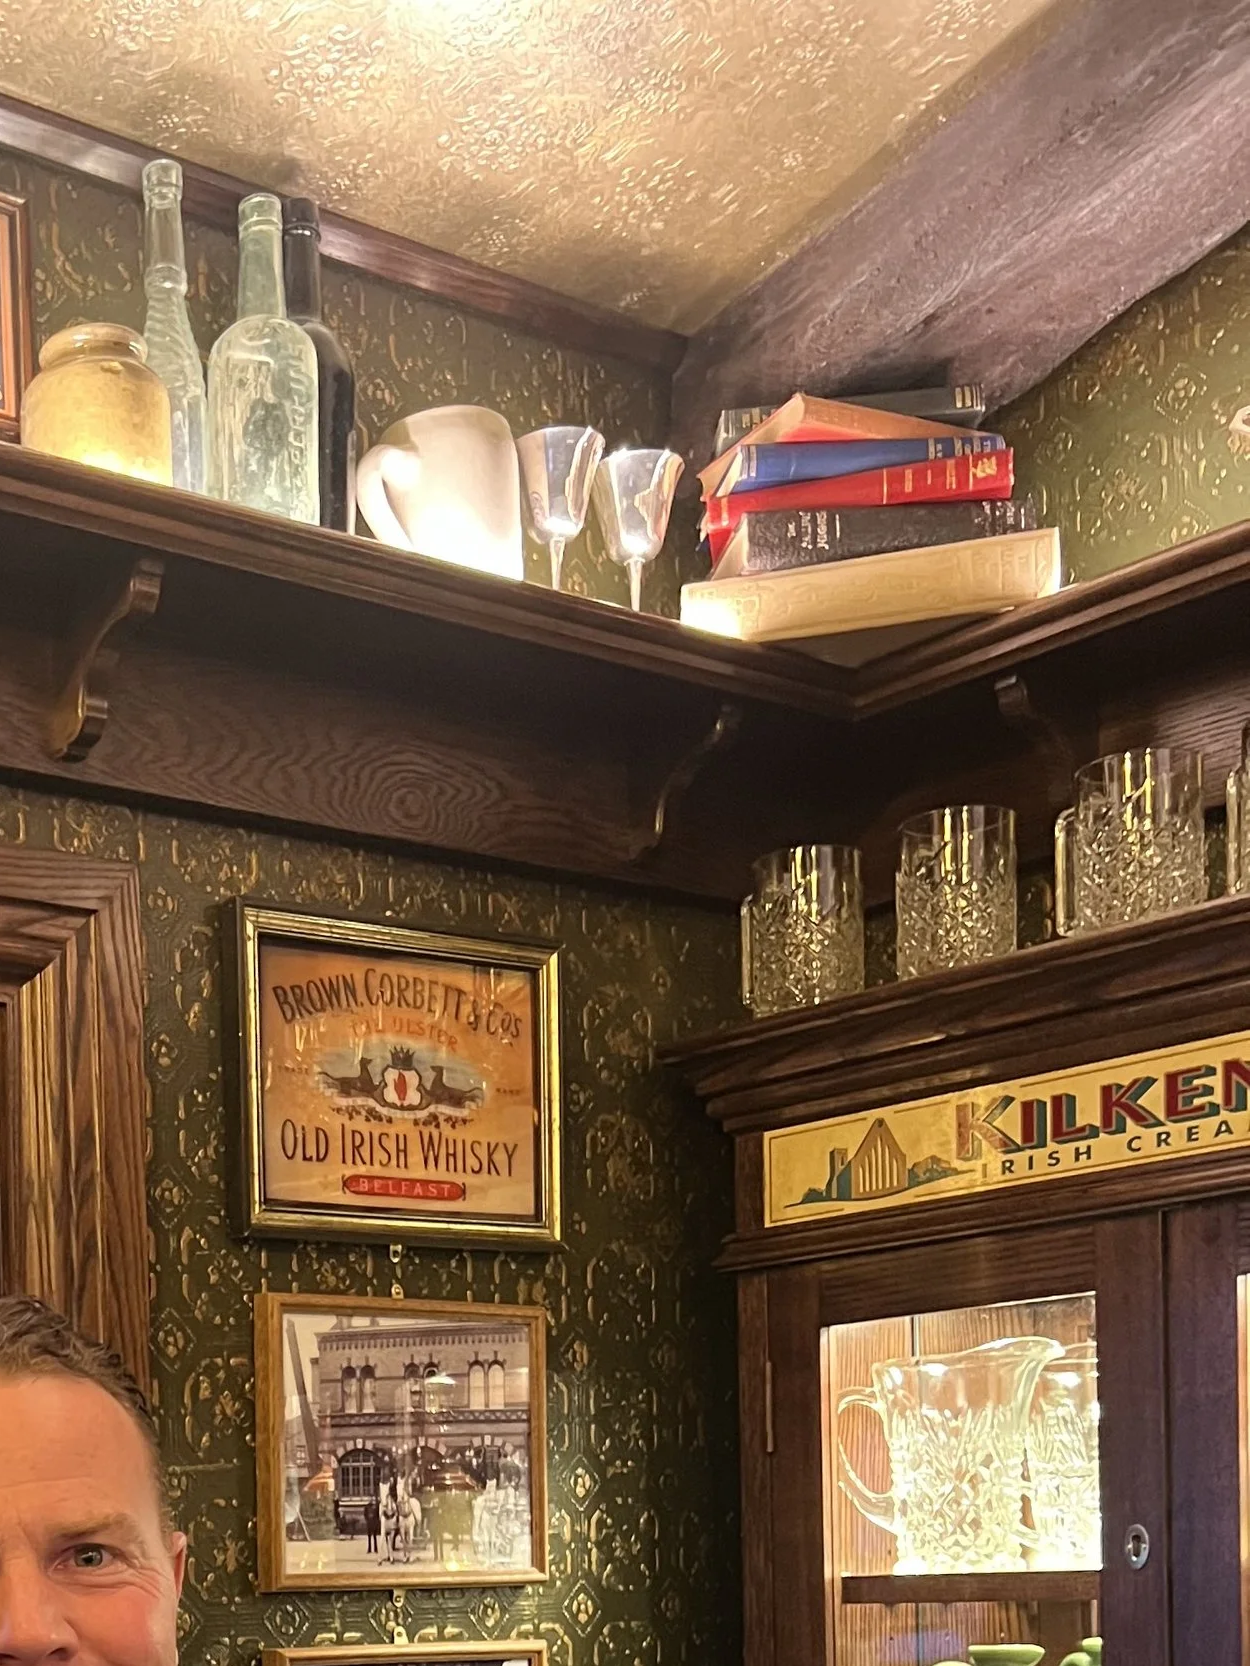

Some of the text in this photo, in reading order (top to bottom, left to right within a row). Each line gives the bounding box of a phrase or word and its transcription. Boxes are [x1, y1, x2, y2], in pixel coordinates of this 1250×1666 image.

[364, 967, 467, 1021] CORBETT
[467, 999, 480, 1032] &
[392, 1016, 459, 1052] ULSTER
[281, 1118, 519, 1177] OLD IRISH WHISKY
[981, 1120, 1250, 1179] IRISH CREA
[359, 1177, 451, 1197] BELFAST
